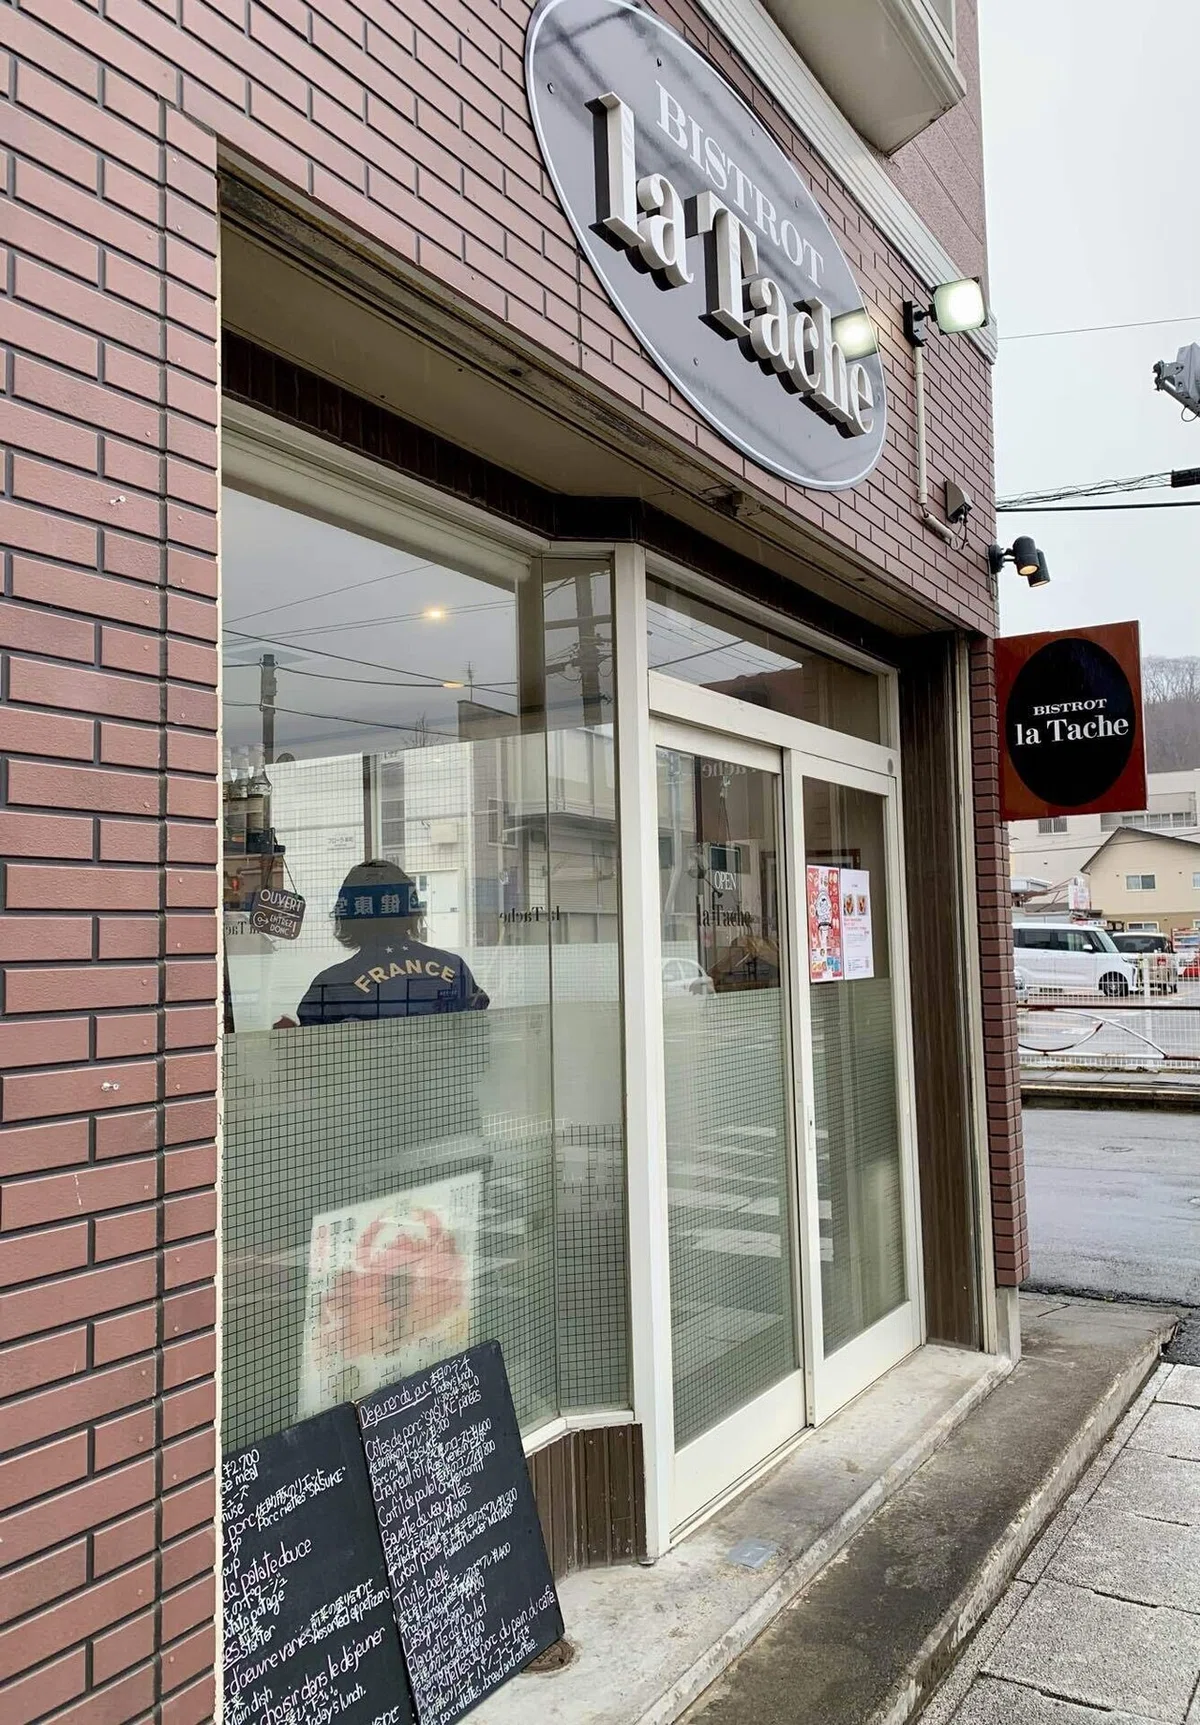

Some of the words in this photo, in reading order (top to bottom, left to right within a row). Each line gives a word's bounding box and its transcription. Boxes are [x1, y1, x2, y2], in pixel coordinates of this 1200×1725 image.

[655, 79, 825, 290] BISTROT
[584, 92, 694, 291] la
[685, 190, 875, 438] Tache
[1032, 698, 1107, 716] BISTROT
[1015, 723, 1042, 746] la
[1046, 715, 1129, 743] Tache
[714, 870, 737, 890] OPEN
[260, 889, 303, 912] OUVERT
[270, 914, 293, 928] ENTREZ
[270, 923, 290, 936] DONC
[353, 959, 456, 993] FRANCE
[400, 1385, 413, 1405] de
[235, 1463, 258, 1485] meal
[222, 1577, 240, 1602] de
[240, 1553, 277, 1597] patate
[278, 1539, 311, 1567] douce
[301, 1671, 327, 1699] dans
[327, 1655, 339, 1679] le
[340, 1627, 384, 1671] déjeuner
[250, 1687, 272, 1712] dish
